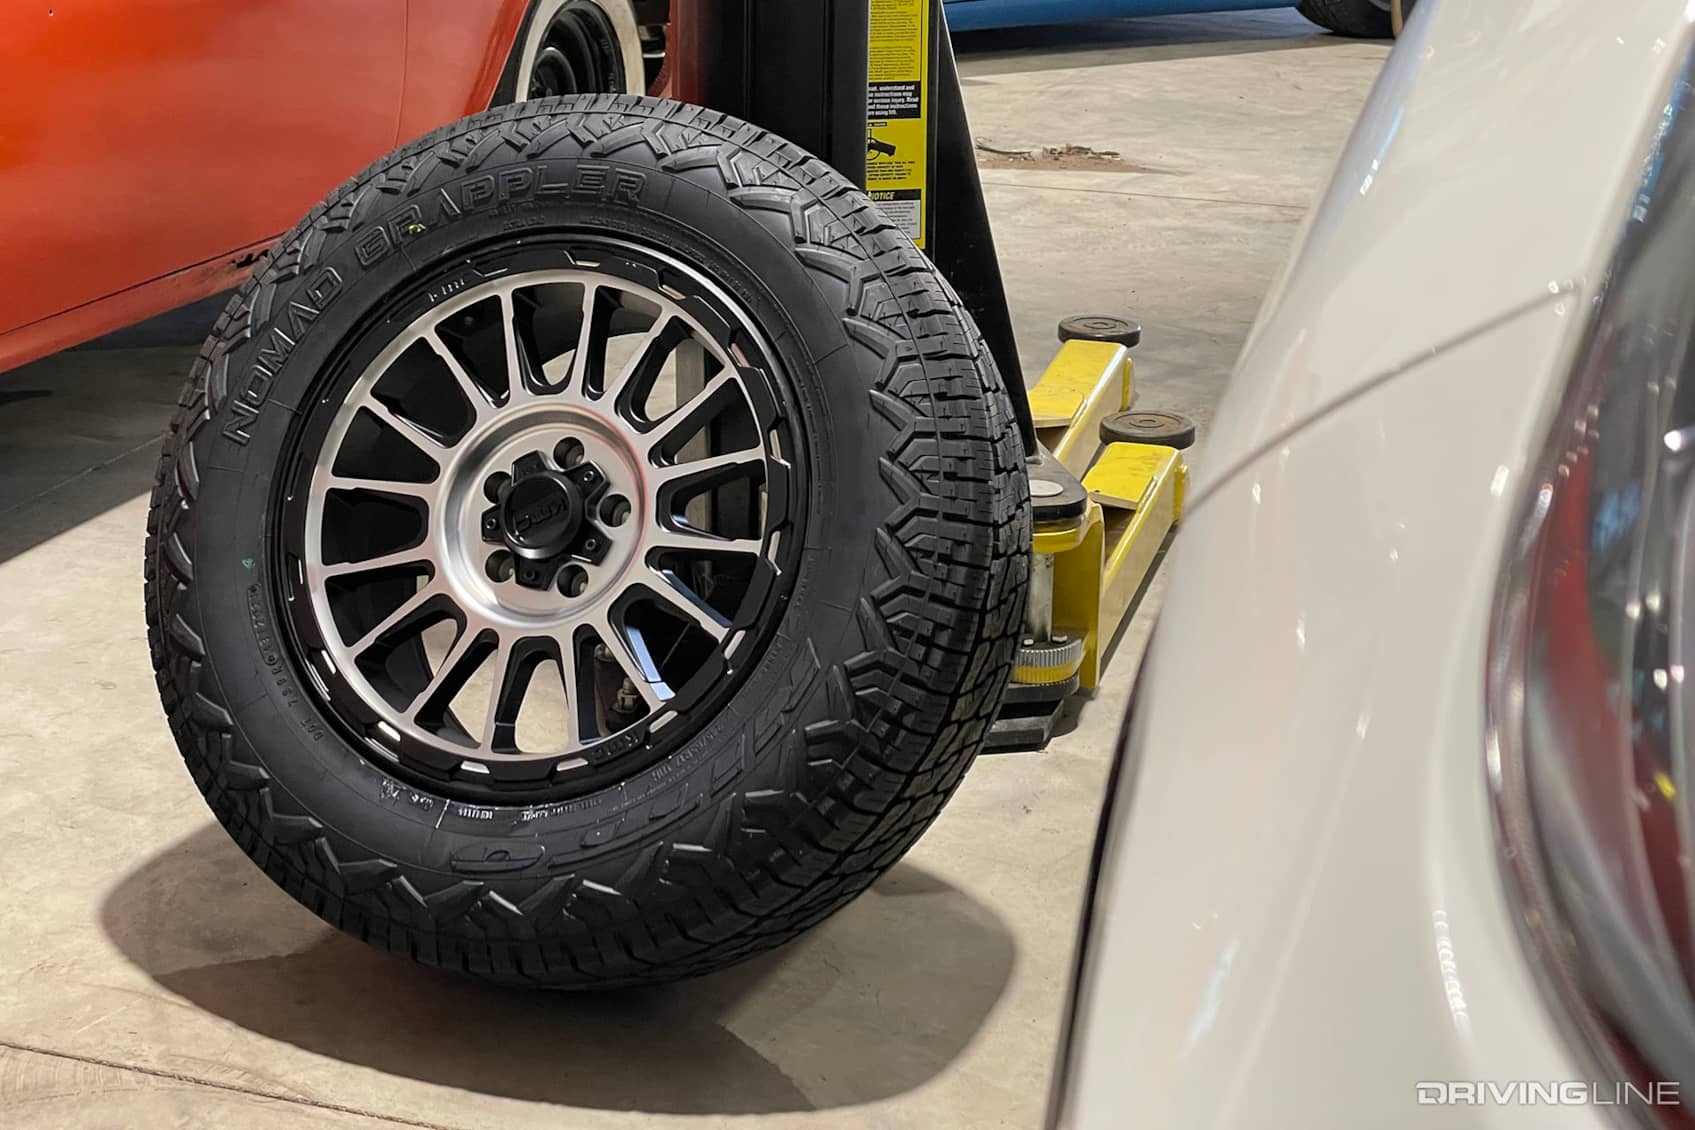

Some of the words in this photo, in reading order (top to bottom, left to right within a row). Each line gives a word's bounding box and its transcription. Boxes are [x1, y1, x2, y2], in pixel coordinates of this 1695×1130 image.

[868, 191, 895, 200] NOTICE
[221, 265, 343, 446] NOMAD
[355, 165, 648, 268] GRAPPLER
